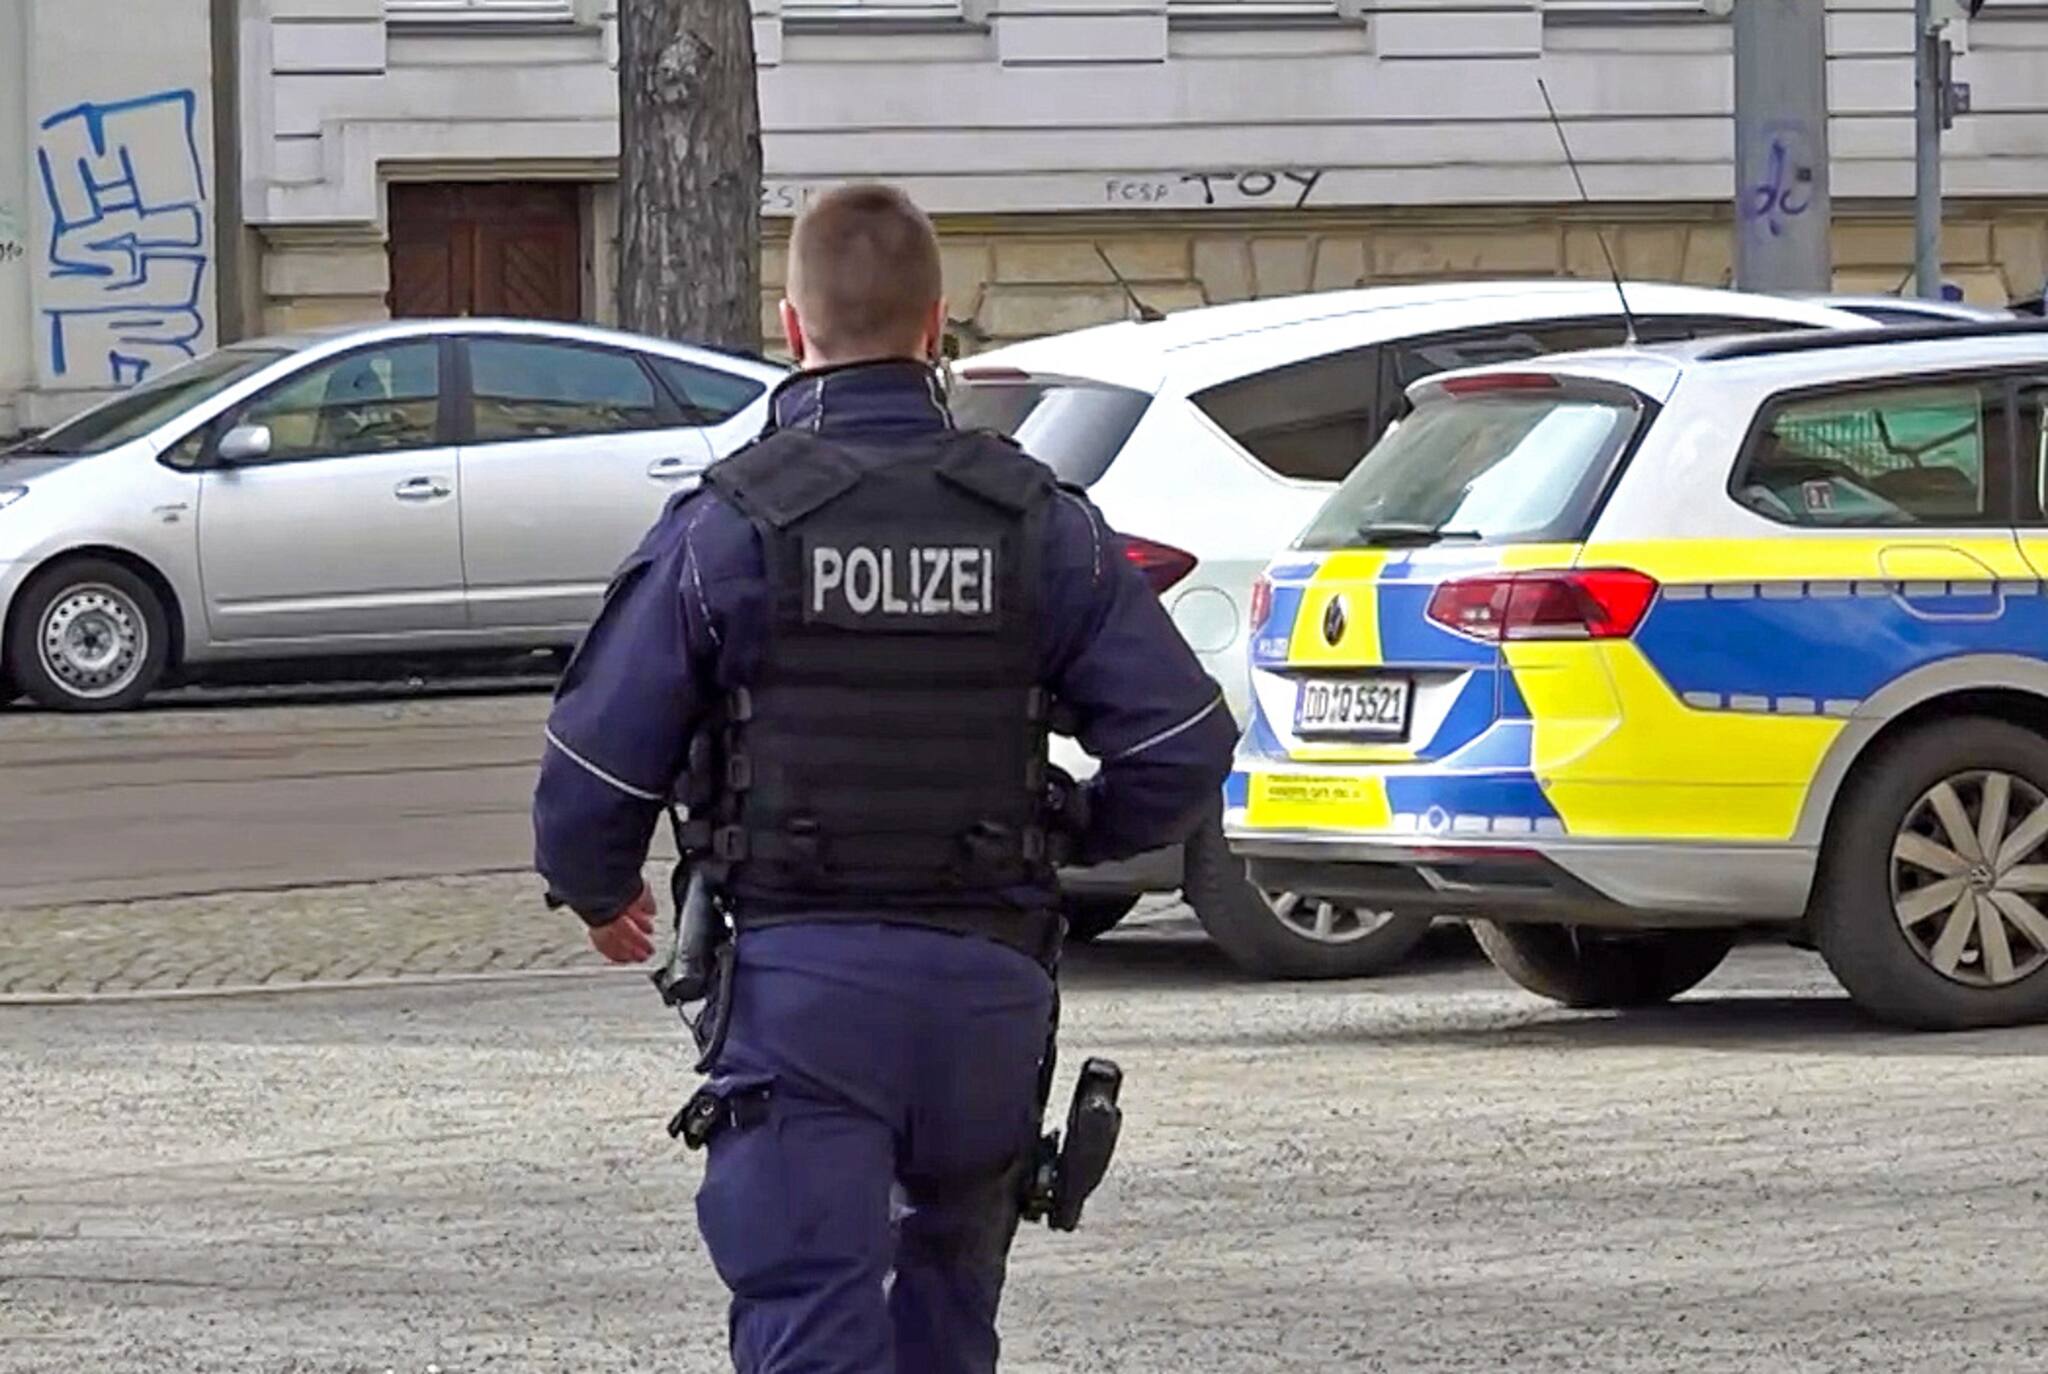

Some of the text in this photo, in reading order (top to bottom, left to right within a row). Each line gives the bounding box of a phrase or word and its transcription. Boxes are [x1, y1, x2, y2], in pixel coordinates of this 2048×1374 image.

[1181, 169, 1323, 208] TOY
[813, 546, 993, 614] POLIZEI
[1355, 685, 1401, 724] 5521
